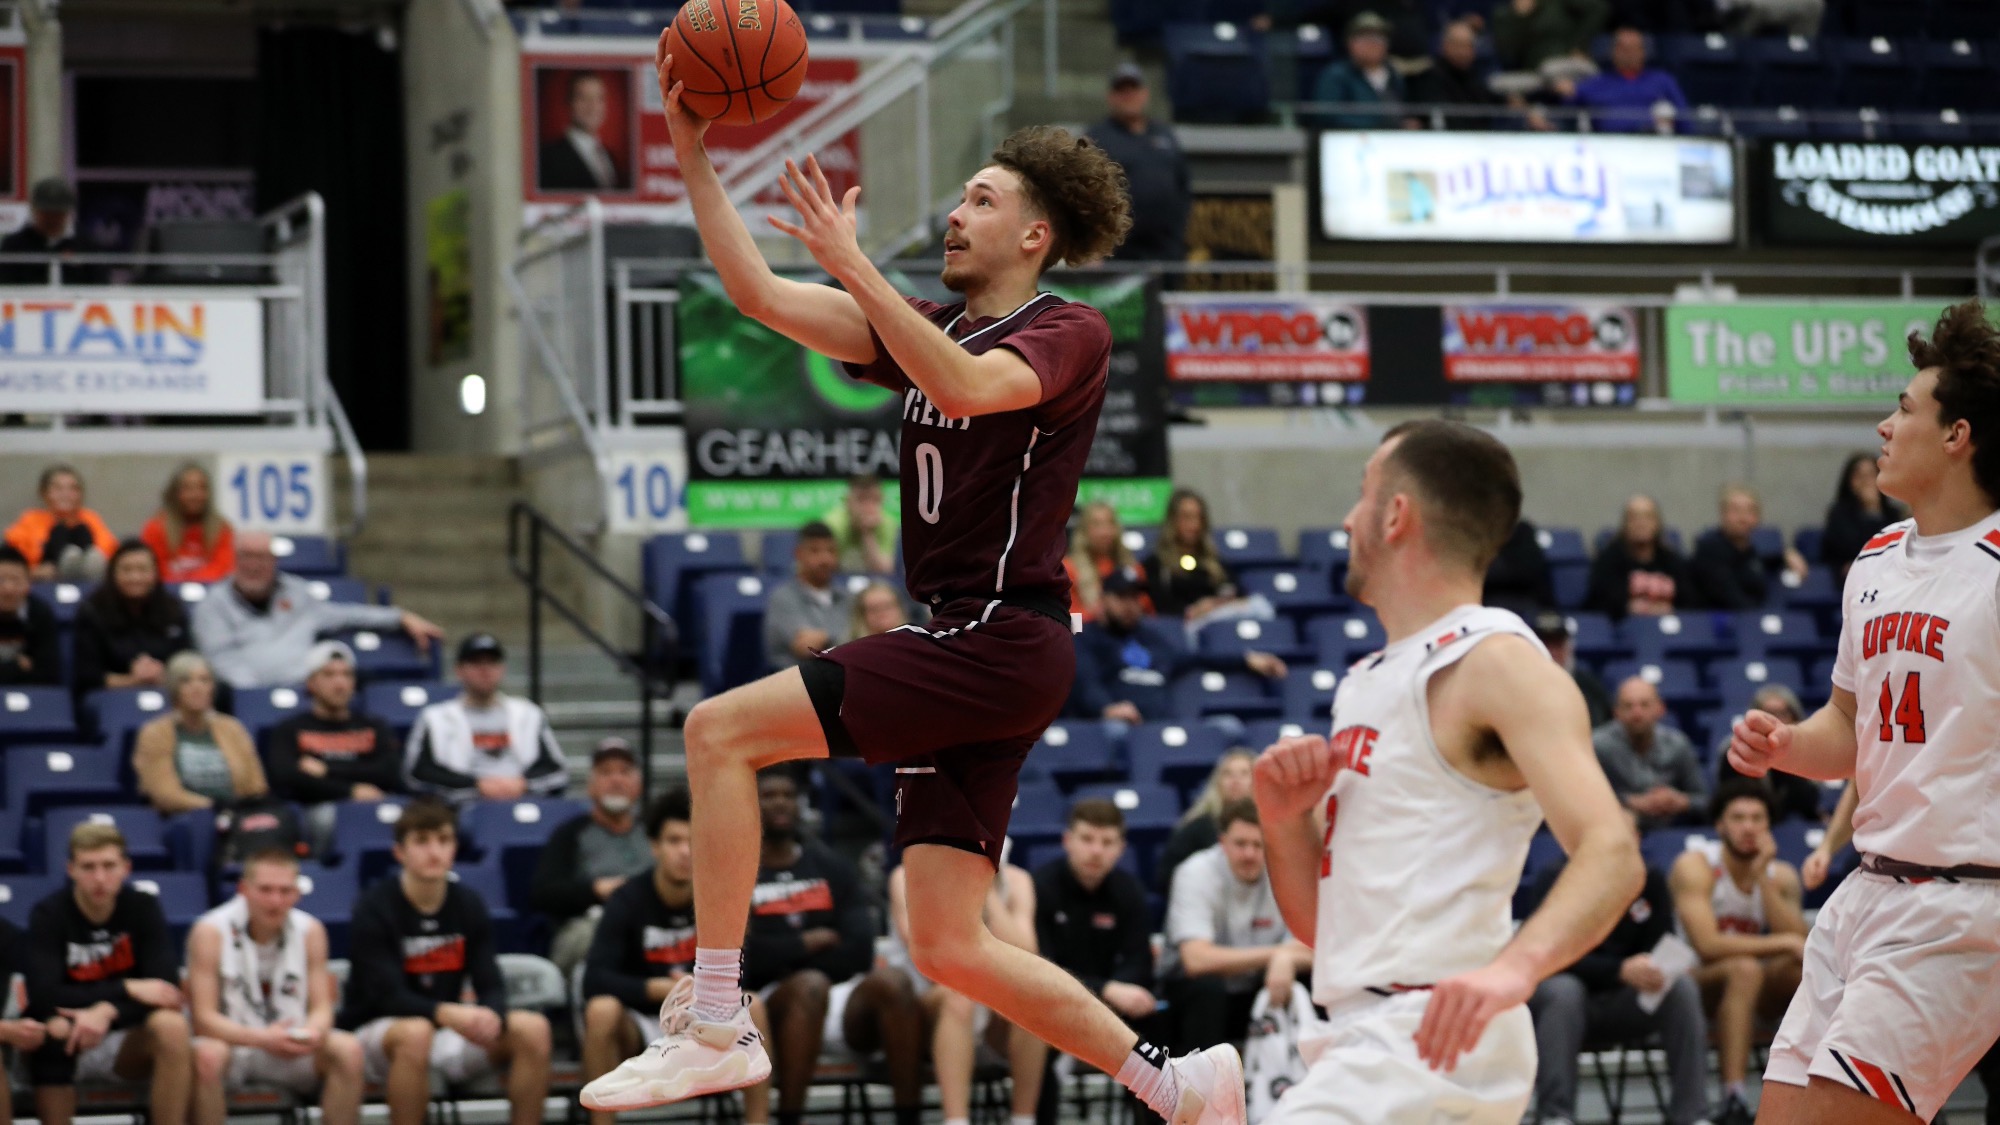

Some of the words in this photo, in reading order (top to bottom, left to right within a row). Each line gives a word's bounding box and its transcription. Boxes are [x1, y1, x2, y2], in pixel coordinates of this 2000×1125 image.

[1773, 142, 1911, 180] LOADED
[0, 302, 206, 353] TAIN
[1686, 319, 1776, 367] The
[1791, 319, 1889, 368] UPS
[75, 372, 207, 393] EXCHANGE
[697, 428, 901, 477] GEARHEA
[231, 464, 313, 521] 105
[916, 443, 944, 524] 0
[1862, 611, 1951, 663] UPIKE
[1879, 671, 1926, 744] 14
